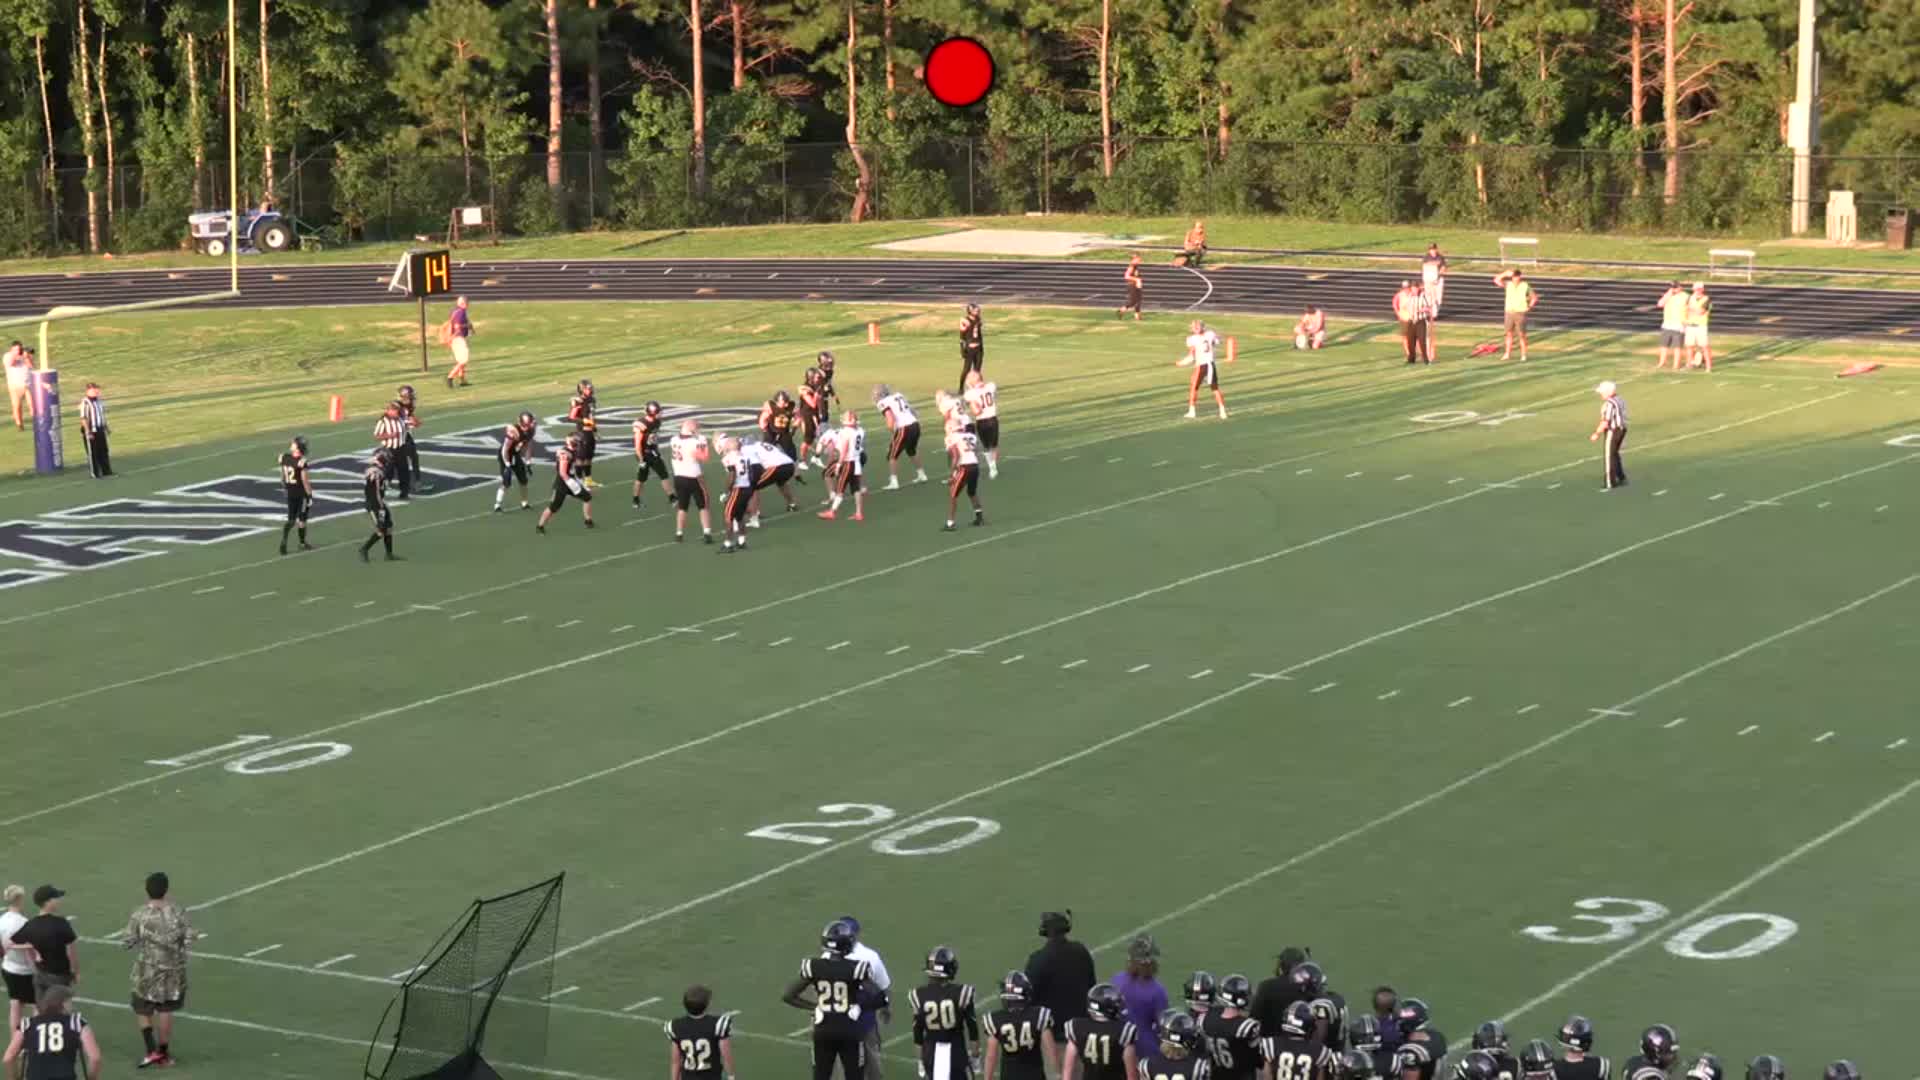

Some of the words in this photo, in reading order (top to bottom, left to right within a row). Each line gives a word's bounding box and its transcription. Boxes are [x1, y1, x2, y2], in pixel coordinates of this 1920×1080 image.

[425, 254, 448, 293] 14
[980, 392, 993, 409] 10
[144, 734, 353, 774] 10
[745, 802, 1001, 855] 20
[1521, 897, 1799, 960] 30
[817, 980, 850, 1014] 29
[923, 1000, 956, 1031] 20
[36, 1021, 64, 1054] 18
[1000, 1021, 1035, 1053] 34
[1083, 1033, 1111, 1065] 41
[680, 1038, 712, 1071] 32
[1276, 1051, 1313, 1080] 83
